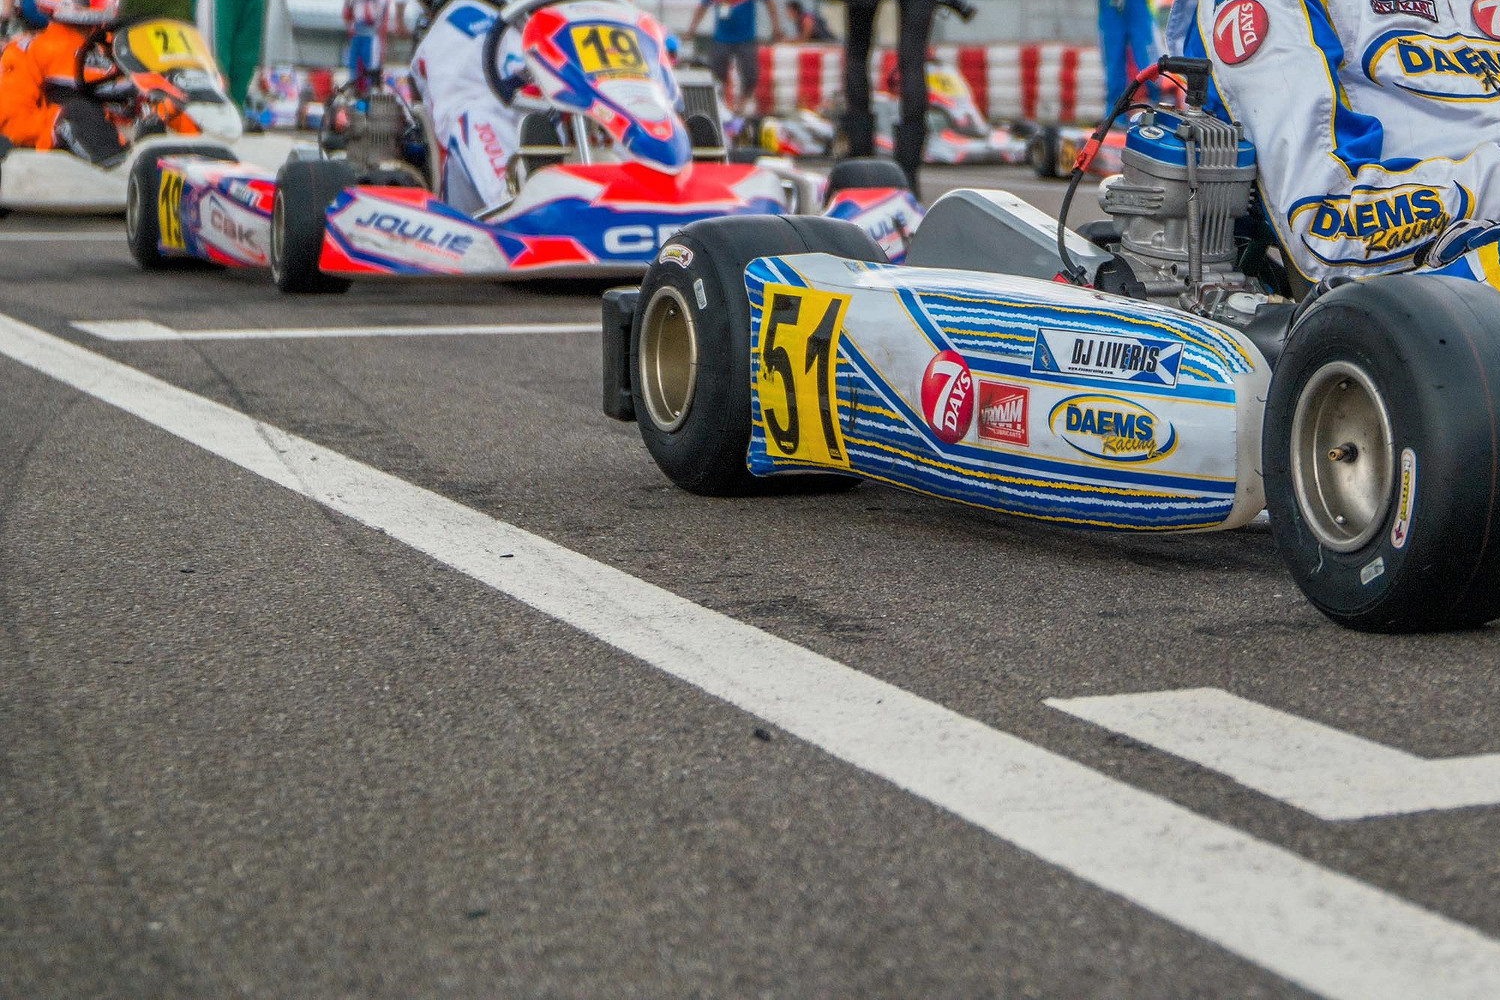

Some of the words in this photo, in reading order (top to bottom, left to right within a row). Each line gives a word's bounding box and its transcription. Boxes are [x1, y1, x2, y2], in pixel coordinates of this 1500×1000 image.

[1216, 4, 1246, 58] 7
[1239, 2, 1258, 47] DAYS
[1401, 1, 1434, 20] KART
[582, 27, 643, 68] 19
[161, 172, 184, 248] 19
[1310, 188, 1443, 237] DAEMS
[1362, 210, 1452, 259] Racing
[763, 292, 844, 461] 51
[1071, 338, 1095, 366] DJ
[1095, 340, 1161, 374] LIVERIS
[931, 360, 964, 432] 7
[944, 370, 972, 433] DAYS
[1066, 406, 1154, 442] DAEMS
